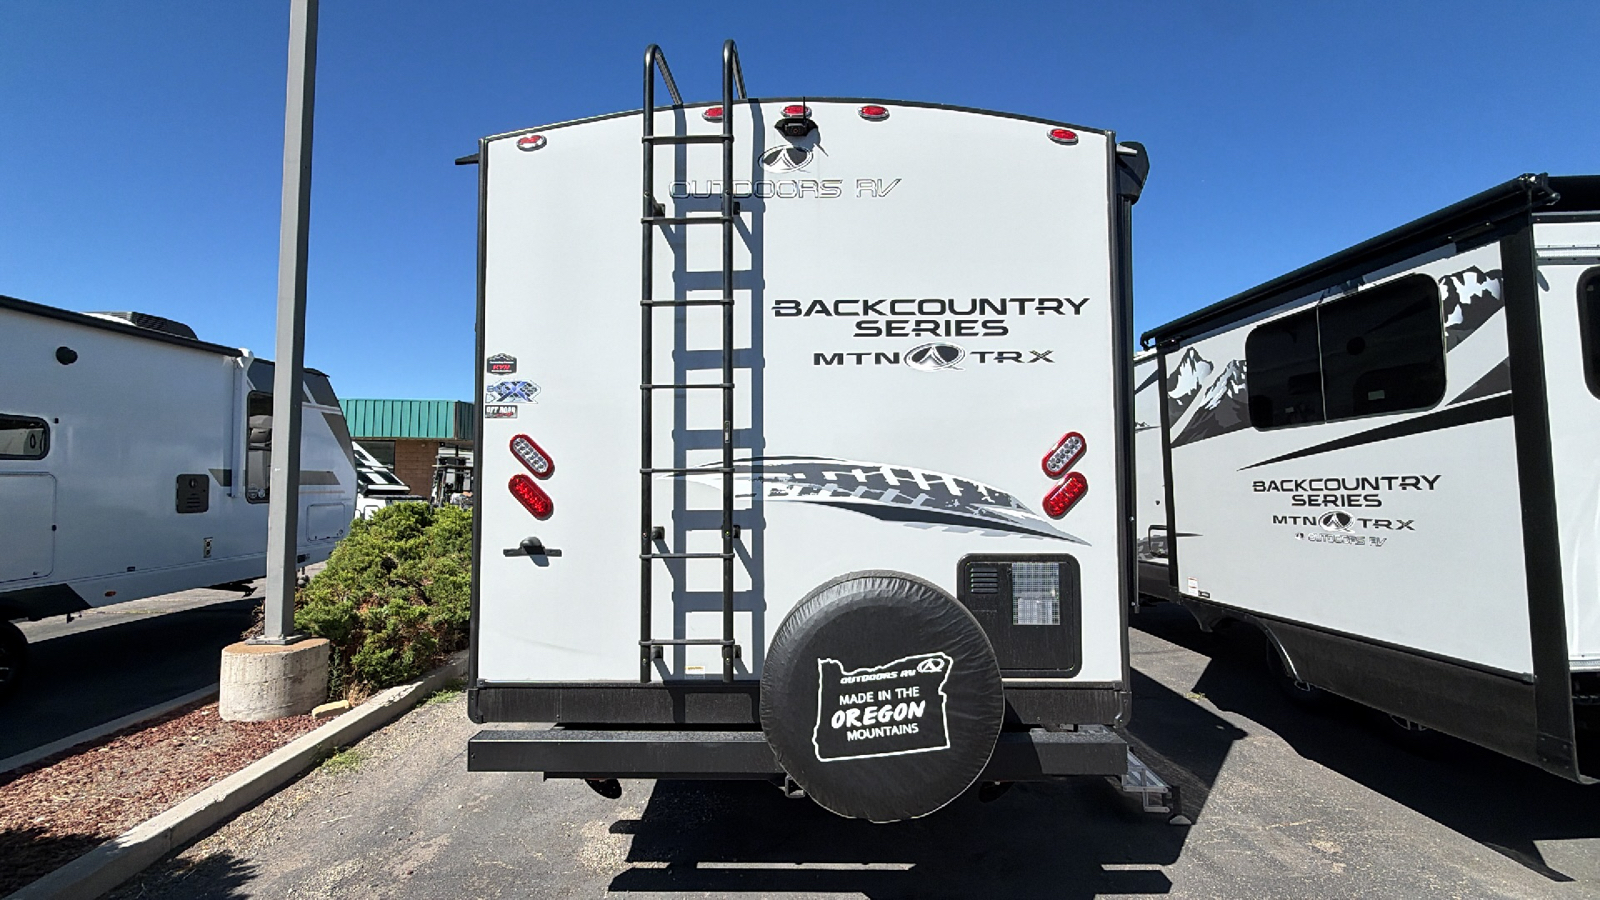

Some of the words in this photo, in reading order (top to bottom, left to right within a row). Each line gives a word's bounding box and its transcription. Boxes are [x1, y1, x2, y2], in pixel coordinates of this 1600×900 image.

[856, 178, 902, 198] RV
[771, 298, 1090, 317] BACKCOUNTRY
[853, 319, 1009, 337] SERIES
[813, 352, 900, 366] MTN
[970, 350, 1055, 364] TRX
[1252, 475, 1442, 492] BACKCOUNTRY
[1291, 493, 1382, 507] SERIES
[1272, 514, 1317, 526] MTN
[1357, 518, 1416, 531] TRX
[840, 671, 897, 683] OUTDOORS
[839, 691, 874, 706] MADE
[878, 689, 892, 701] IN
[895, 686, 920, 699] THE
[831, 700, 926, 729] OREGON
[846, 722, 919, 741] MOUNTAINS
